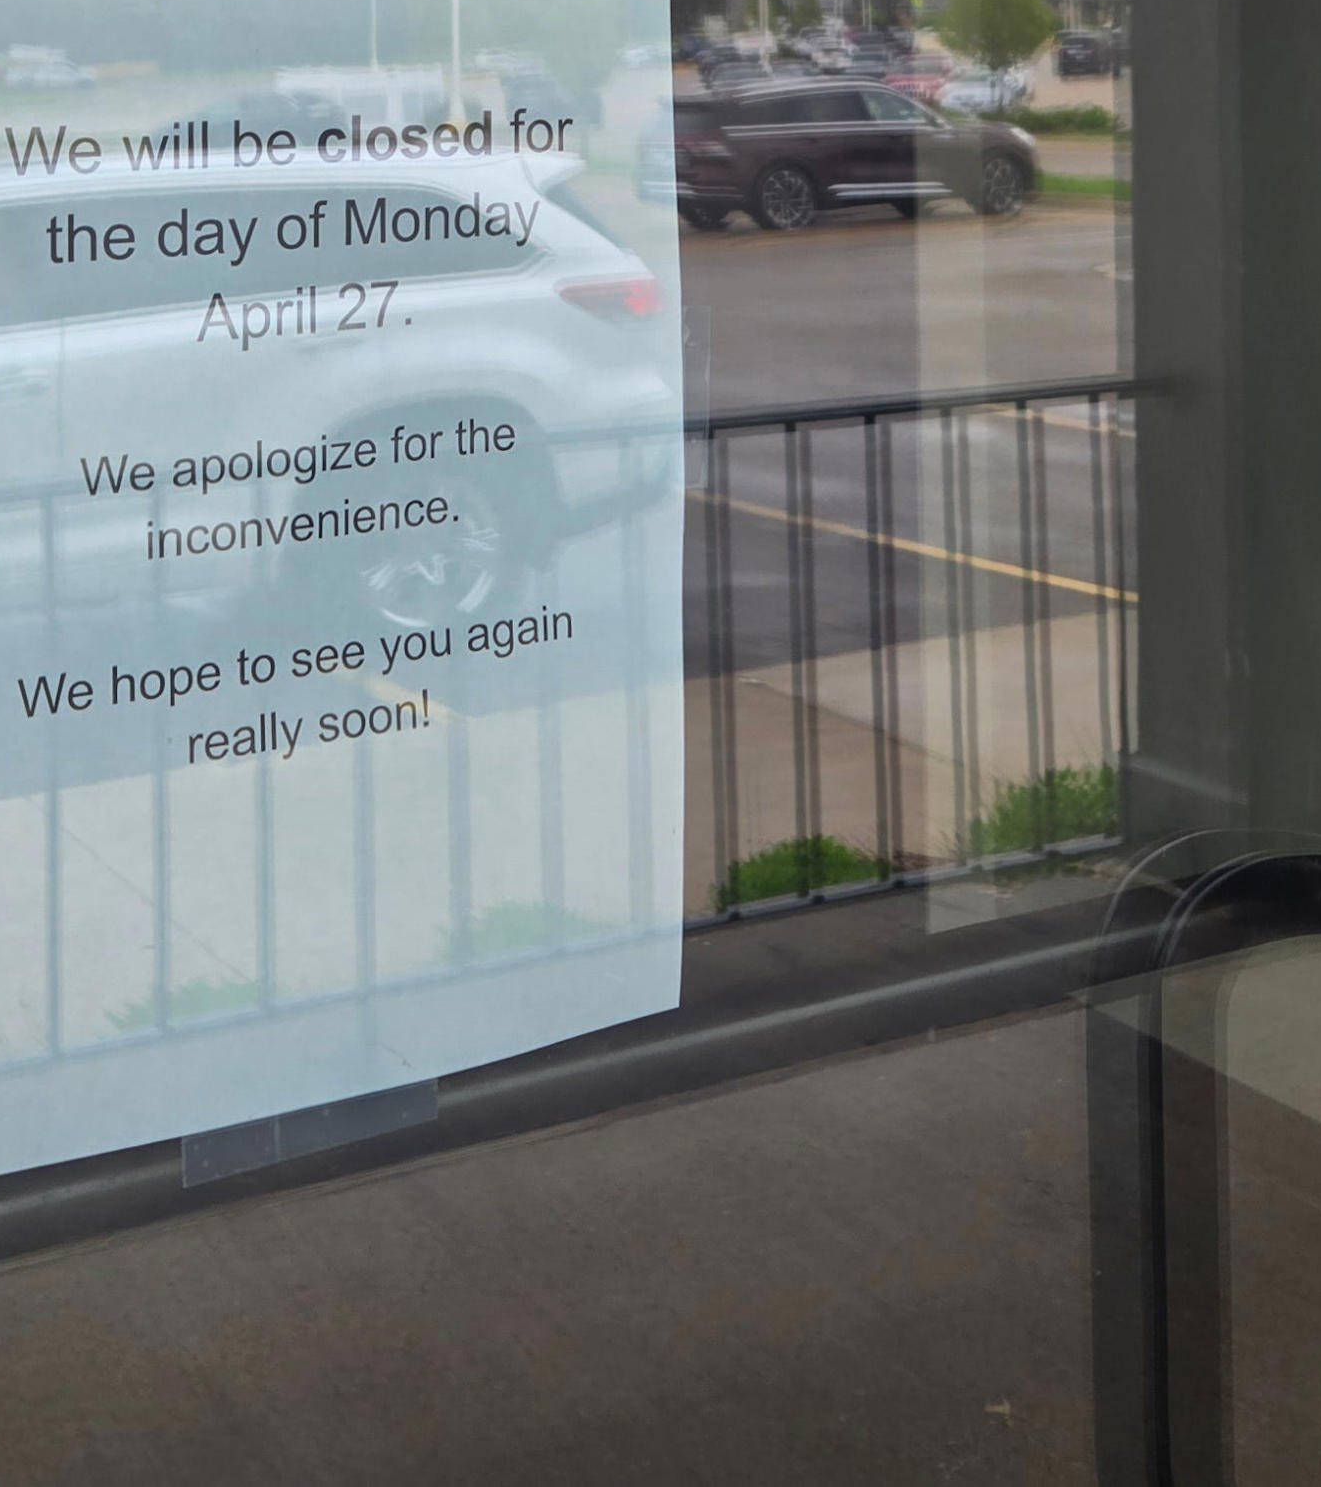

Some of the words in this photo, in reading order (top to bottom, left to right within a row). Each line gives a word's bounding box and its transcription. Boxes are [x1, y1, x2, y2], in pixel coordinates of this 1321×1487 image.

[4, 125, 102, 176] We
[121, 120, 209, 171] will
[233, 119, 297, 168] be
[317, 108, 493, 163] closed
[509, 107, 574, 154] for
[45, 213, 136, 264] the
[157, 207, 259, 267] day
[276, 199, 329, 250] of
[344, 191, 540, 248] Monday
[196, 285, 317, 352] April
[337, 280, 412, 332] 27.
[79, 453, 156, 497] We
[172, 434, 377, 496] apologize
[389, 424, 444, 464] for
[454, 417, 516, 456] the
[147, 496, 459, 561] inconvenience.
[17, 671, 94, 719] We
[111, 661, 222, 708] hope
[236, 648, 276, 686] to
[291, 640, 366, 678] see
[379, 627, 452, 676] you
[467, 604, 573, 659] again
[188, 710, 304, 765] really
[318, 688, 430, 743] soon!
